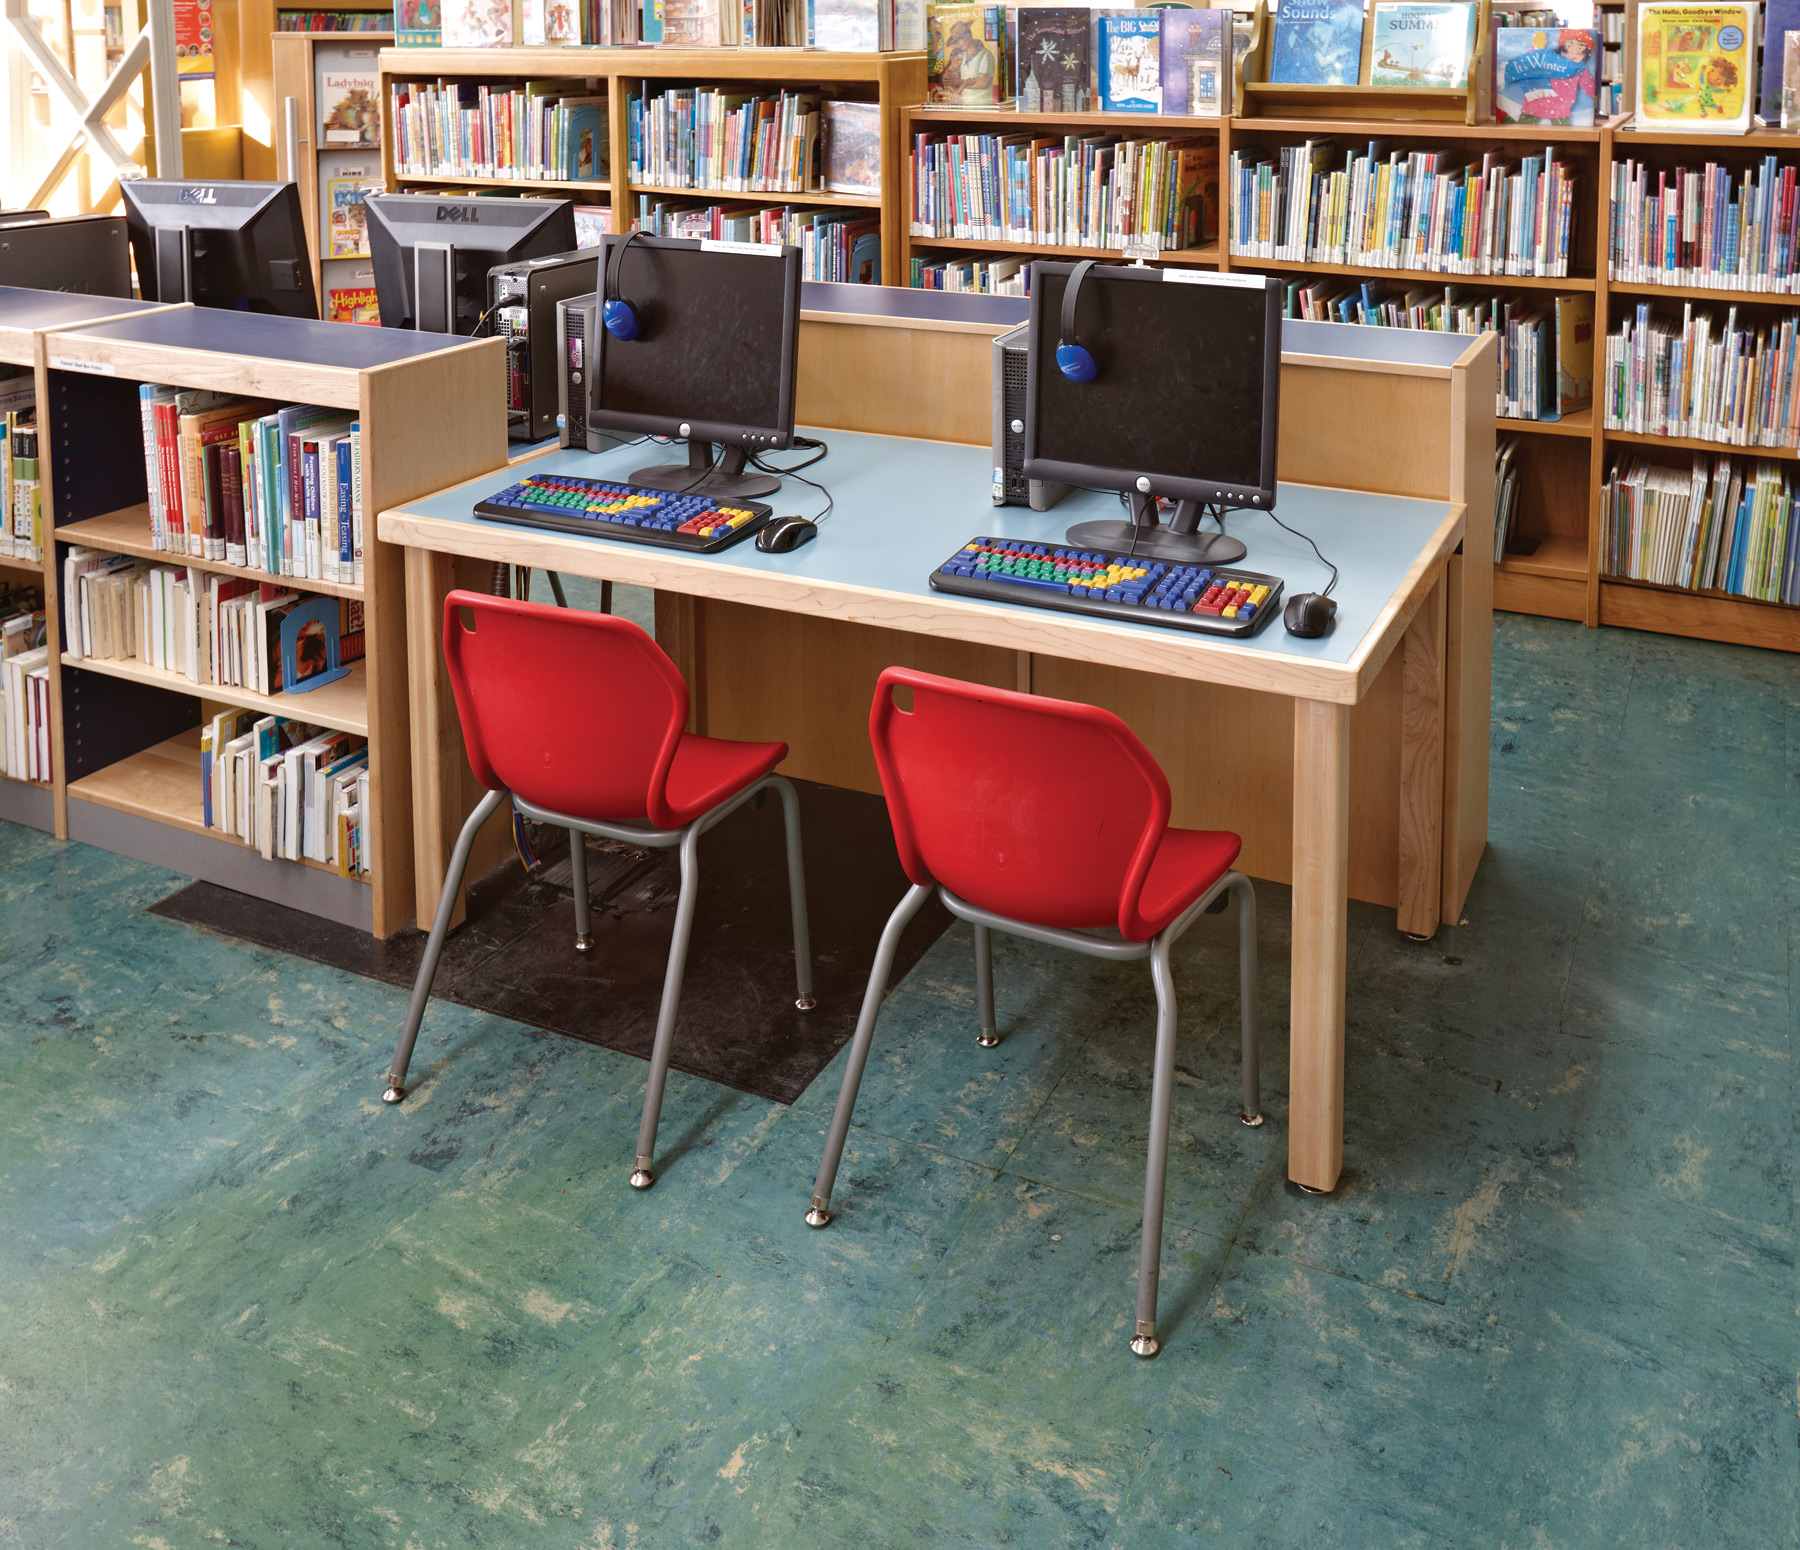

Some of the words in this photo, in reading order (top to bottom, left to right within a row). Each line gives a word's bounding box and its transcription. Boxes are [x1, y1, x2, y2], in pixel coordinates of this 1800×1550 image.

[929, 8, 971, 19] Manuela's
[972, 7, 992, 18] Gift
[1282, 6, 1336, 19] Sounds
[1026, 32, 1037, 42] The
[1035, 26, 1065, 35] Snowflake
[1066, 26, 1087, 35] Sisters
[1104, 20, 1120, 33] The
[1120, 21, 1137, 33] BIG
[1513, 60, 1528, 74] It's
[1526, 53, 1567, 73] Winter
[326, 77, 374, 88] Ladybug
[179, 187, 217, 204] DELL
[436, 205, 479, 222] DELL
[333, 290, 378, 309] Highligh
[329, 475, 337, 515] HYPERACTIVE
[339, 483, 349, 513] Easing
[17, 507, 22, 517] of
[322, 501, 327, 510] MY
[17, 520, 22, 532] Me
[330, 518, 338, 537] CHILD
[340, 520, 350, 553] Teasing
[274, 586, 289, 597] My
